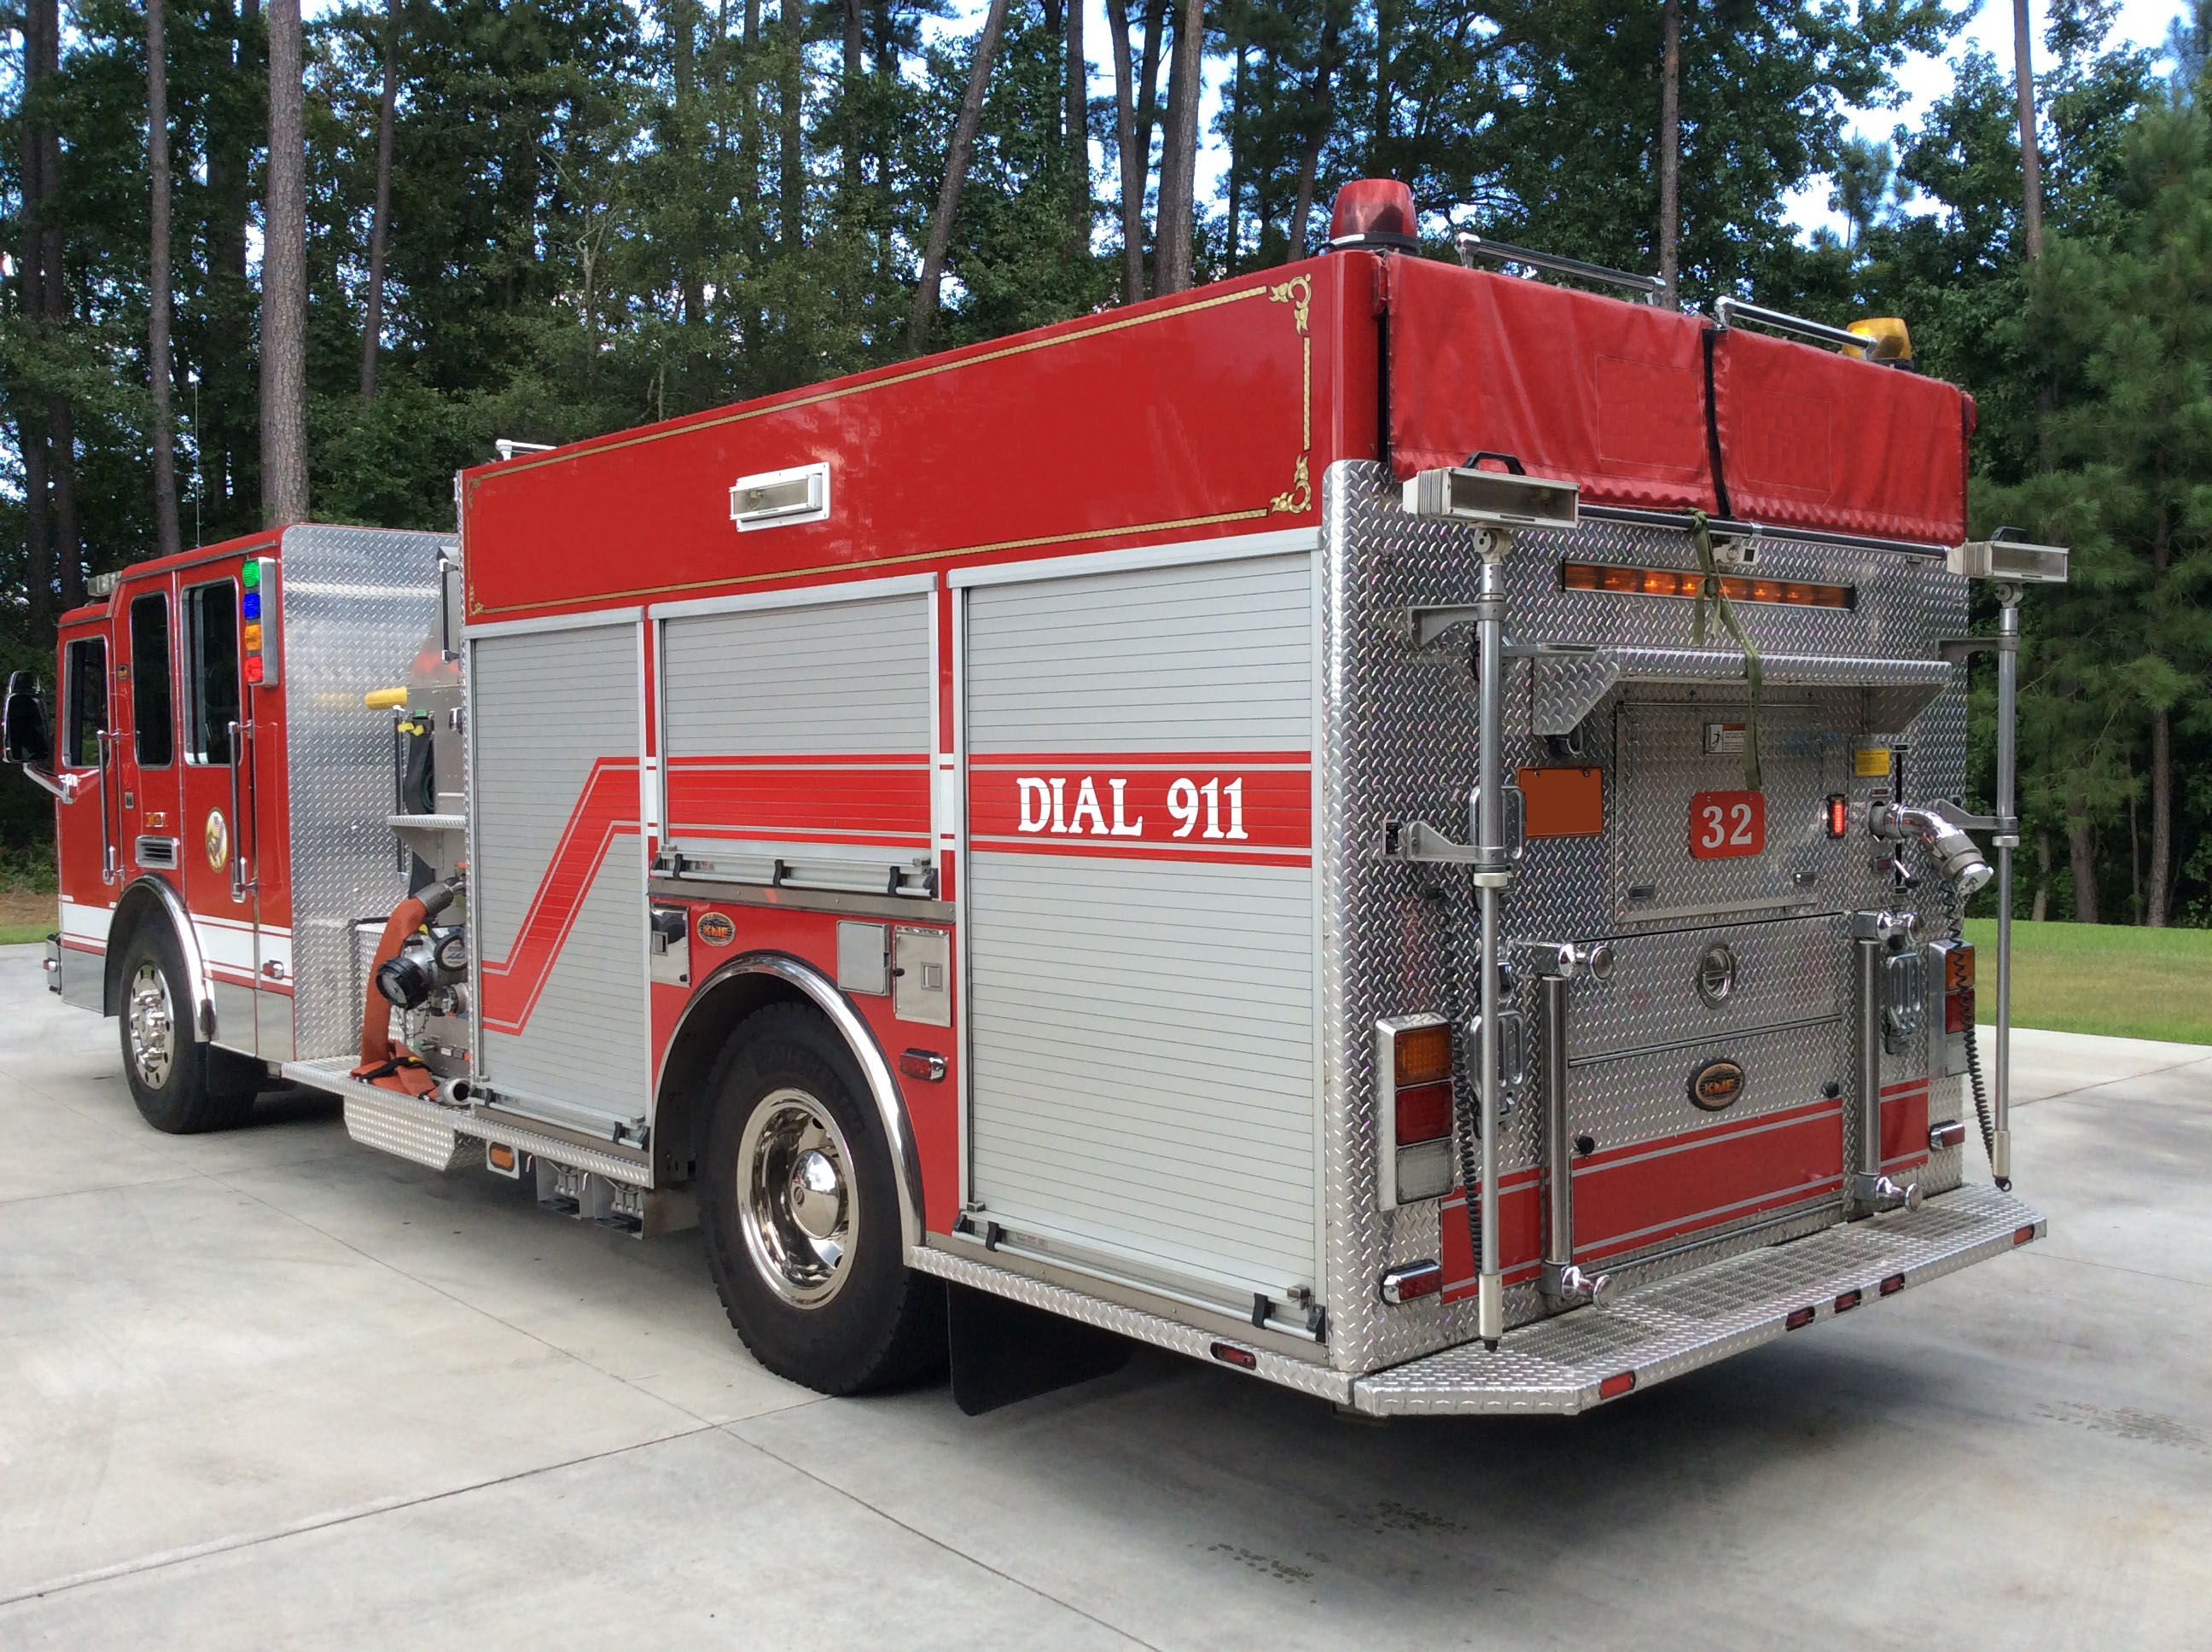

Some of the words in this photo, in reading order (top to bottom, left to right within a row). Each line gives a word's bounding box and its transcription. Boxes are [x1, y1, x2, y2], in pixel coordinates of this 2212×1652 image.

[1016, 776, 1144, 837] DIAL
[1167, 777, 1249, 839] 911
[1702, 803, 1752, 848] 32
